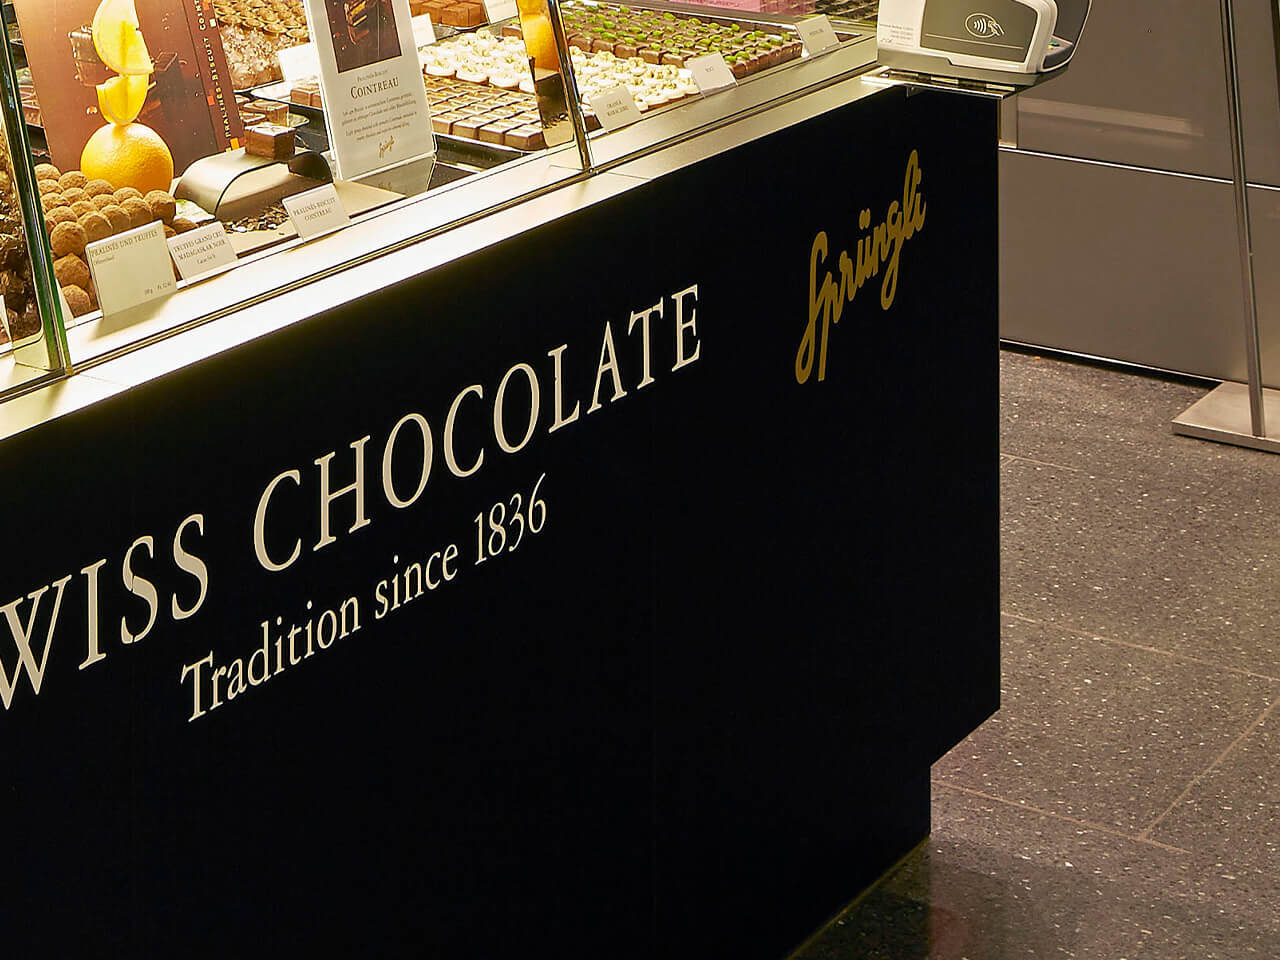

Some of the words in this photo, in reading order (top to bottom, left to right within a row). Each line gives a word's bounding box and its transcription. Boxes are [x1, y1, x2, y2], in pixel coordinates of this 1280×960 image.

[350, 76, 399, 99] COINTREAU
[120, 238, 133, 248] UND
[795, 149, 926, 384] Sprüngli
[254, 284, 701, 571] CHOCOLATE
[181, 595, 360, 722] Tradition
[374, 541, 458, 620] since
[474, 473, 548, 566] 1836
